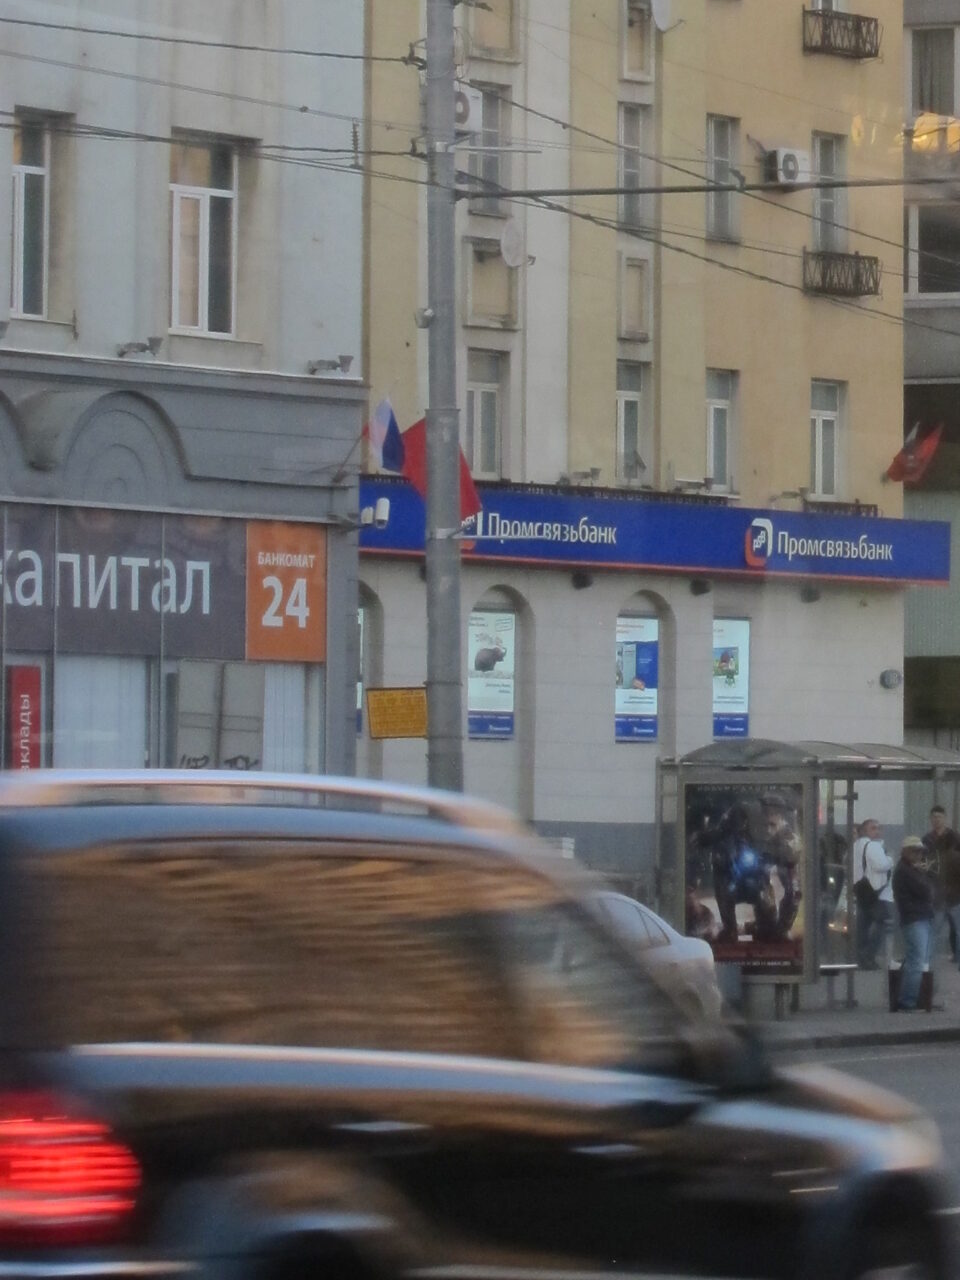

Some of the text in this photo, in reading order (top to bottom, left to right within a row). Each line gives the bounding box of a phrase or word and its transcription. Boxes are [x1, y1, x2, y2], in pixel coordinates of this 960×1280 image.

[488, 513, 617, 545] Промсвязьбанк
[257, 551, 316, 569] БАНКОМАТ
[778, 531, 894, 561] Промсвязьбанк
[261, 576, 310, 629] 24
